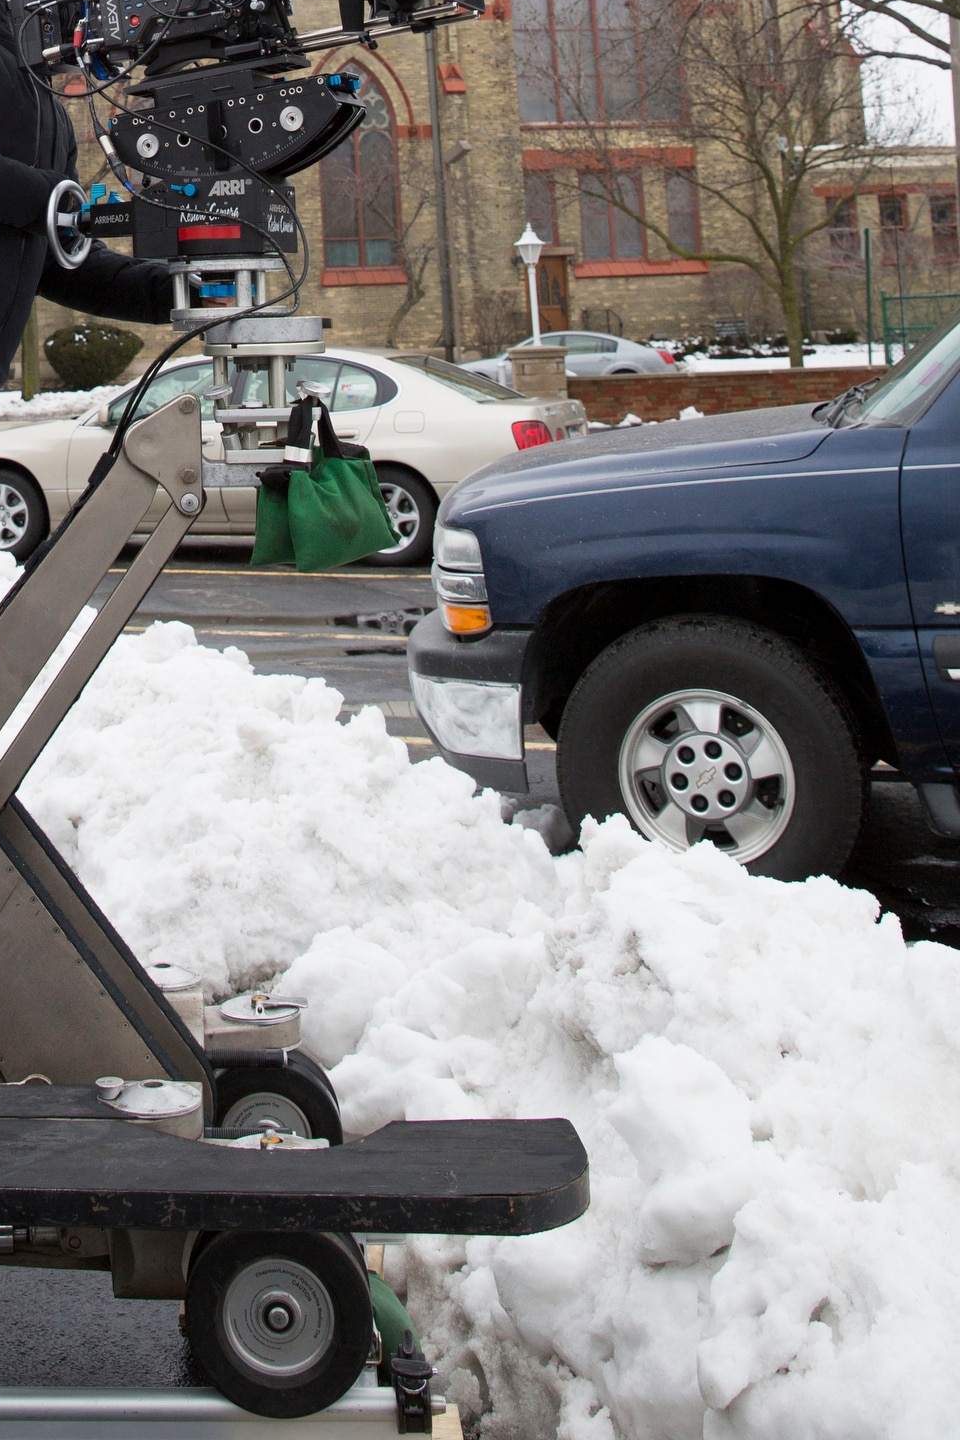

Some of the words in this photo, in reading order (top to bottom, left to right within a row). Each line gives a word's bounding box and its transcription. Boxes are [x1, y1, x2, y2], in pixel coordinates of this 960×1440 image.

[208, 179, 245, 197] ARRI
[95, 215, 124, 225] ARRIHEAD
[124, 213, 130, 222] 2
[291, 1279, 312, 1302] CAUTION
